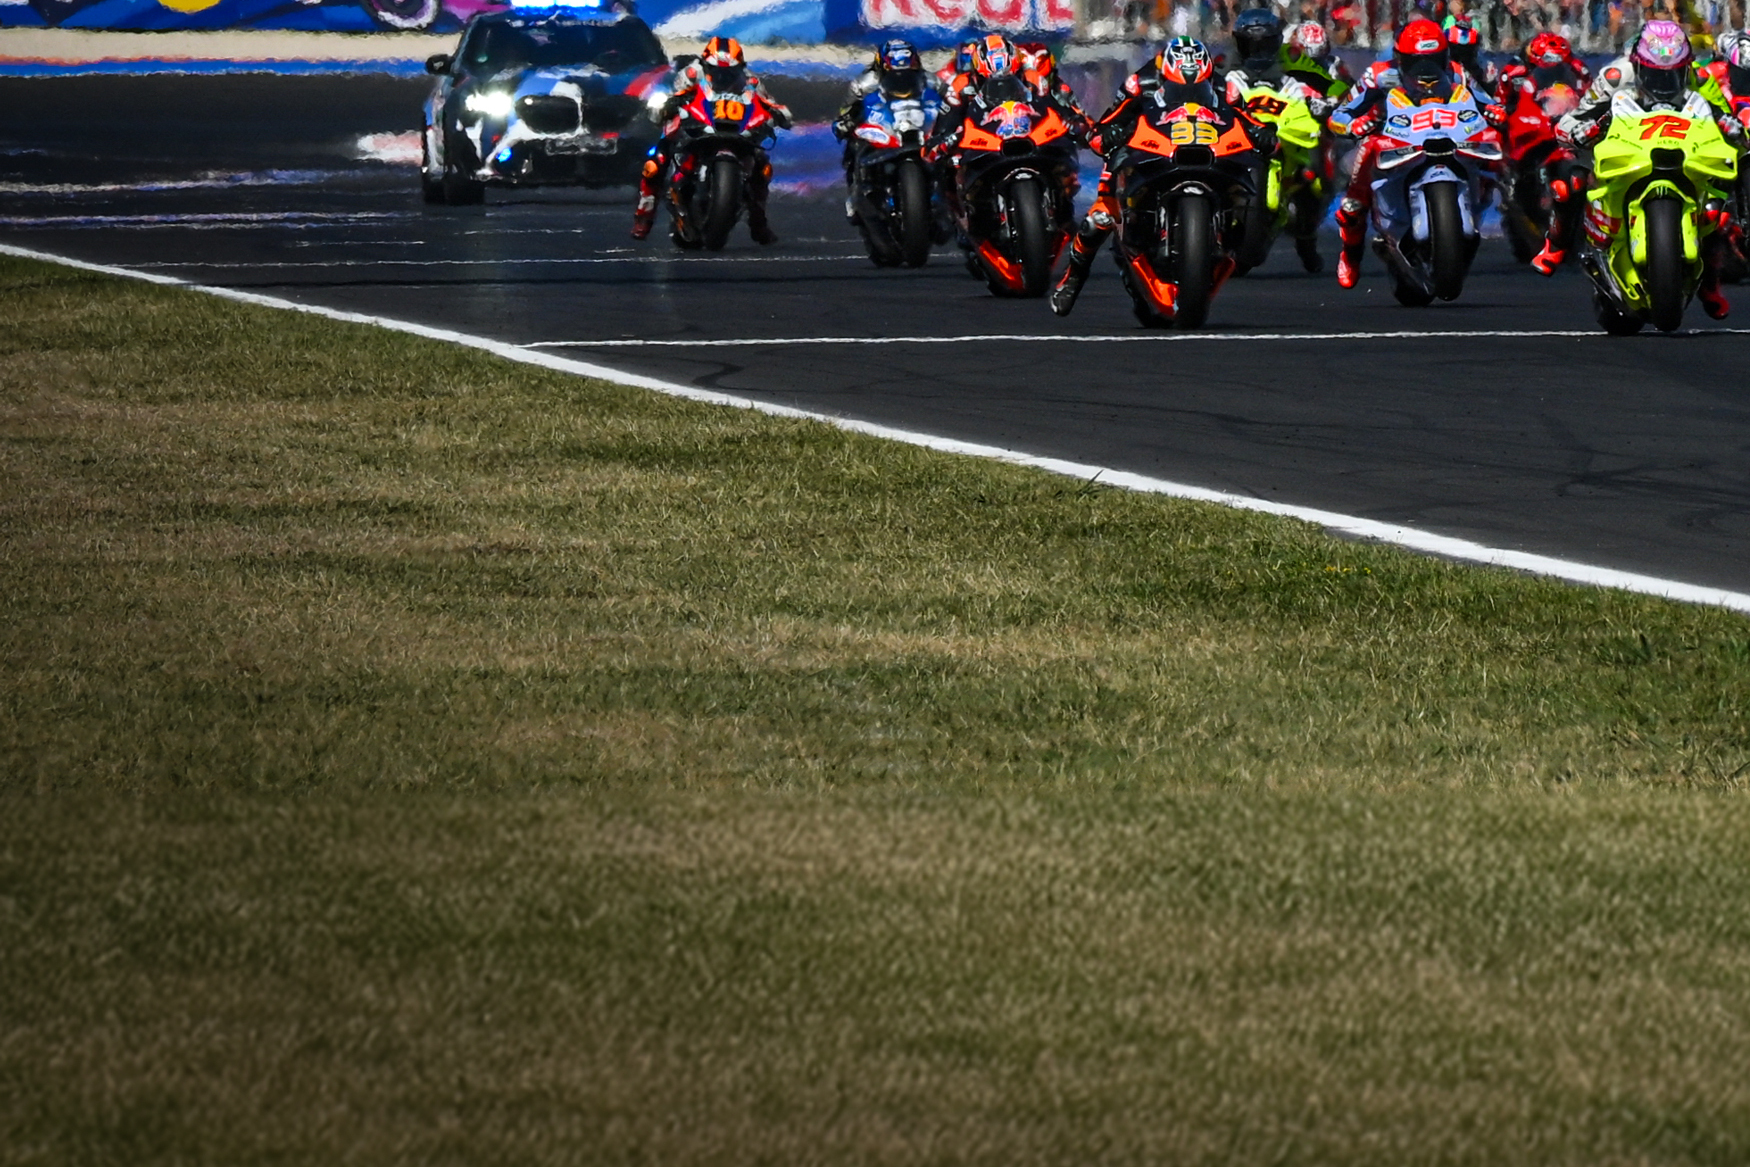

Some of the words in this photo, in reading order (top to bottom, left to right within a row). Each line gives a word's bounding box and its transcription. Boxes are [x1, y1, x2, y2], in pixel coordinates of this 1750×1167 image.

[714, 100, 744, 120] 10
[1412, 108, 1458, 133] 93
[1171, 121, 1218, 145] 33
[1639, 115, 1691, 140] 72
